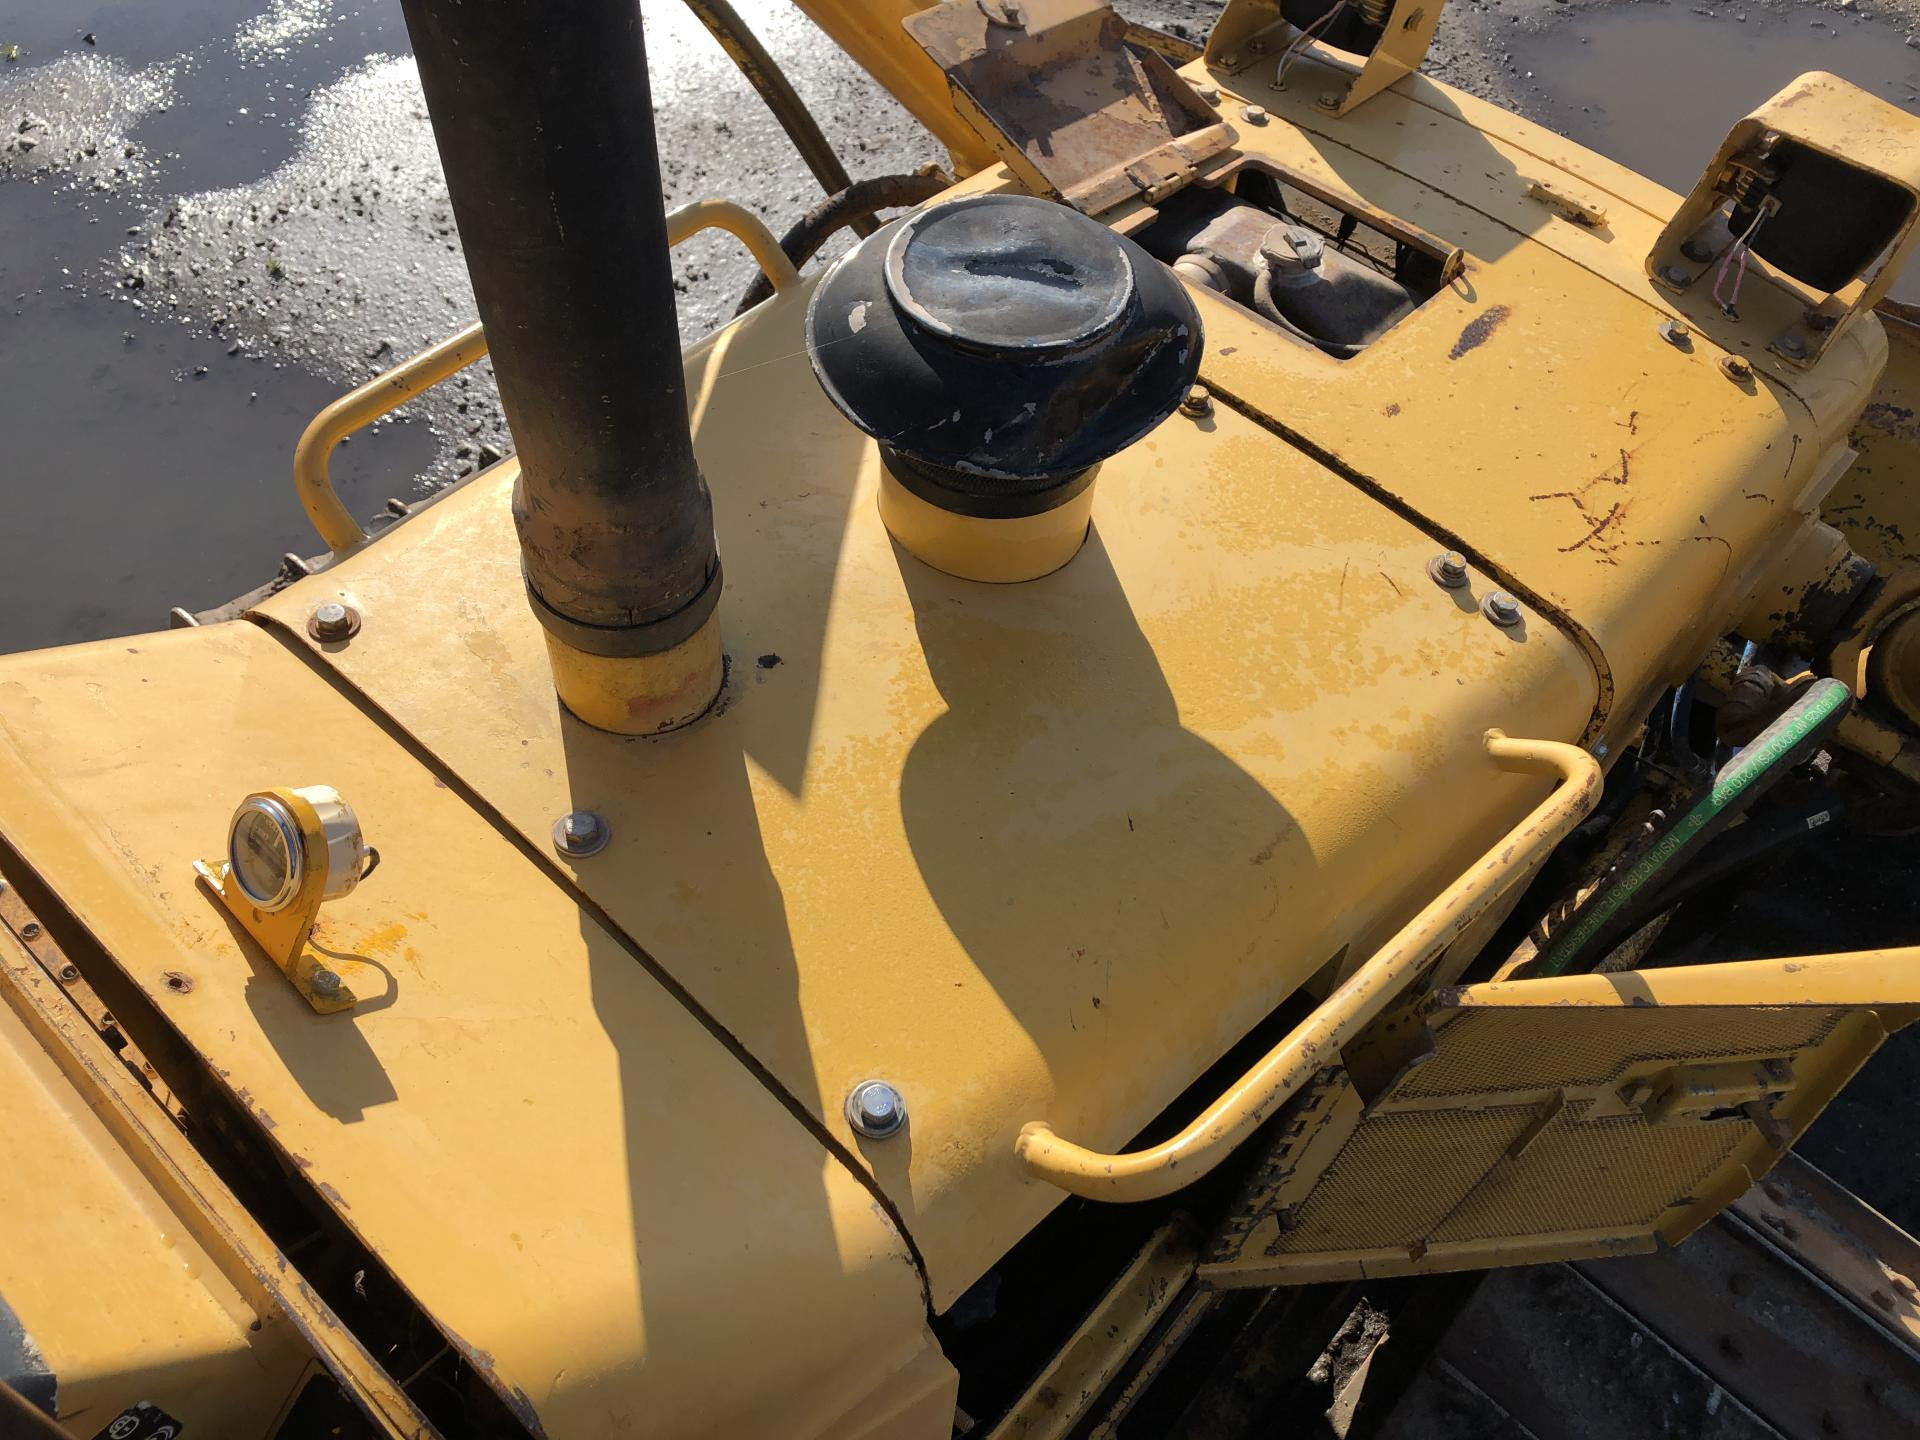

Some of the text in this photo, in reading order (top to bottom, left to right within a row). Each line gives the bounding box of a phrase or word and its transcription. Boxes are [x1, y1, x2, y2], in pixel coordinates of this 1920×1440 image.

[1770, 729, 1798, 754] 3000
[1732, 768, 1754, 789] 210
[1648, 834, 1681, 865] MSHA
